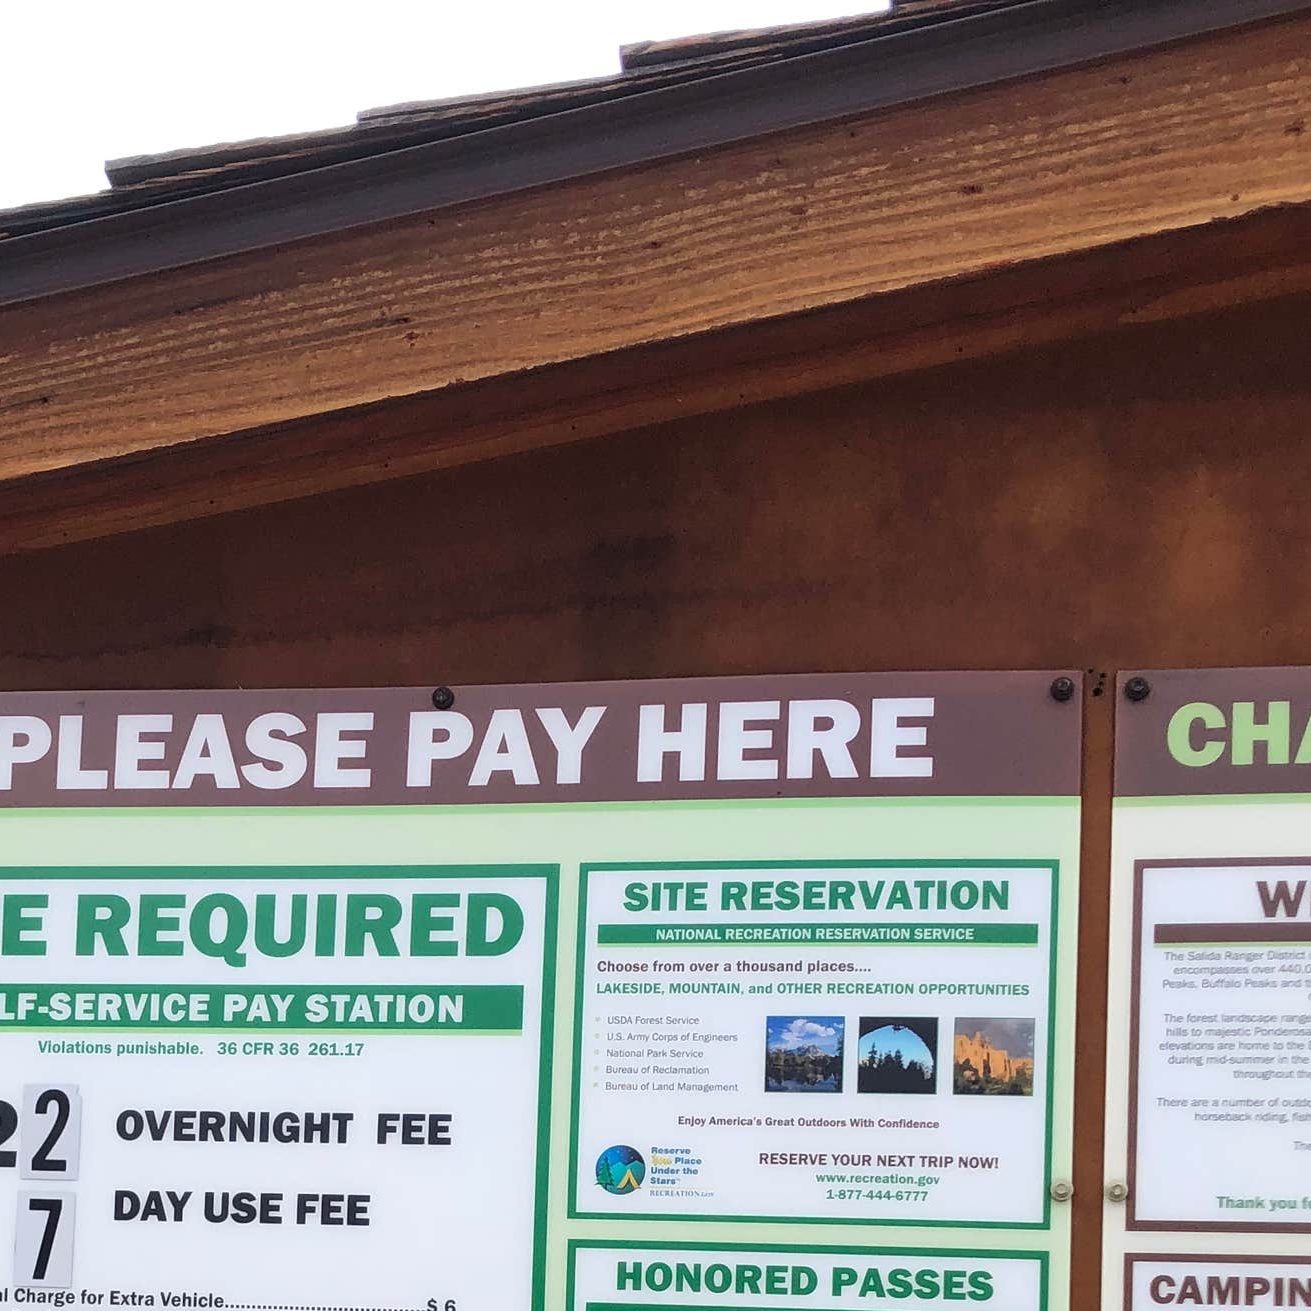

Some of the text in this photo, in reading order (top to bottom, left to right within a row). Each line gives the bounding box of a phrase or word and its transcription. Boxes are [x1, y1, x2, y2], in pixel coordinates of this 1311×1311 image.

[1167, 701, 1311, 766] CH
[406, 706, 606, 786] PAY
[637, 698, 934, 782] HERE
[623, 880, 1008, 911] SITE RESERVATION
[76, 893, 524, 967] REQUIRED
[656, 928, 973, 940] NATIONAL RECREATION RESERVATION SERVICE
[597, 960, 648, 971] Choose
[653, 960, 684, 971] from
[689, 963, 718, 971] over
[723, 963, 731, 971] a
[736, 960, 802, 971] thousand
[596, 983, 1029, 995] LAKESIDE, MOUNTAIN, and OTHER RECREATION OPPORTUNITIES
[223, 994, 294, 1021] PAY
[305, 994, 463, 1022] STATION
[607, 1016, 699, 1024] USDA Forest Service
[38, 1040, 363, 1056] Violations punishable. 36 CFR 36 261.17
[606, 1049, 703, 1057] National Park Service
[116, 1110, 353, 1143] OVERNIGHT
[377, 1113, 451, 1144] FEE
[759, 1153, 998, 1168] RESERVE YOUR NEXT TRIP NOW!
[816, 1174, 939, 1186] www.recreation.gov
[826, 1189, 927, 1201] 1-877-444-6777
[1216, 1196, 1297, 1211] Thank you
[29, 1198, 63, 1280] 7
[114, 1190, 192, 1221] DAY
[204, 1192, 282, 1223] USE
[296, 1193, 370, 1225] FEE
[617, 1261, 993, 1300] HONORED PASSES
[14, 1288, 75, 1307] Charge
[81, 1289, 103, 1304] for
[110, 1290, 154, 1305] Extra
